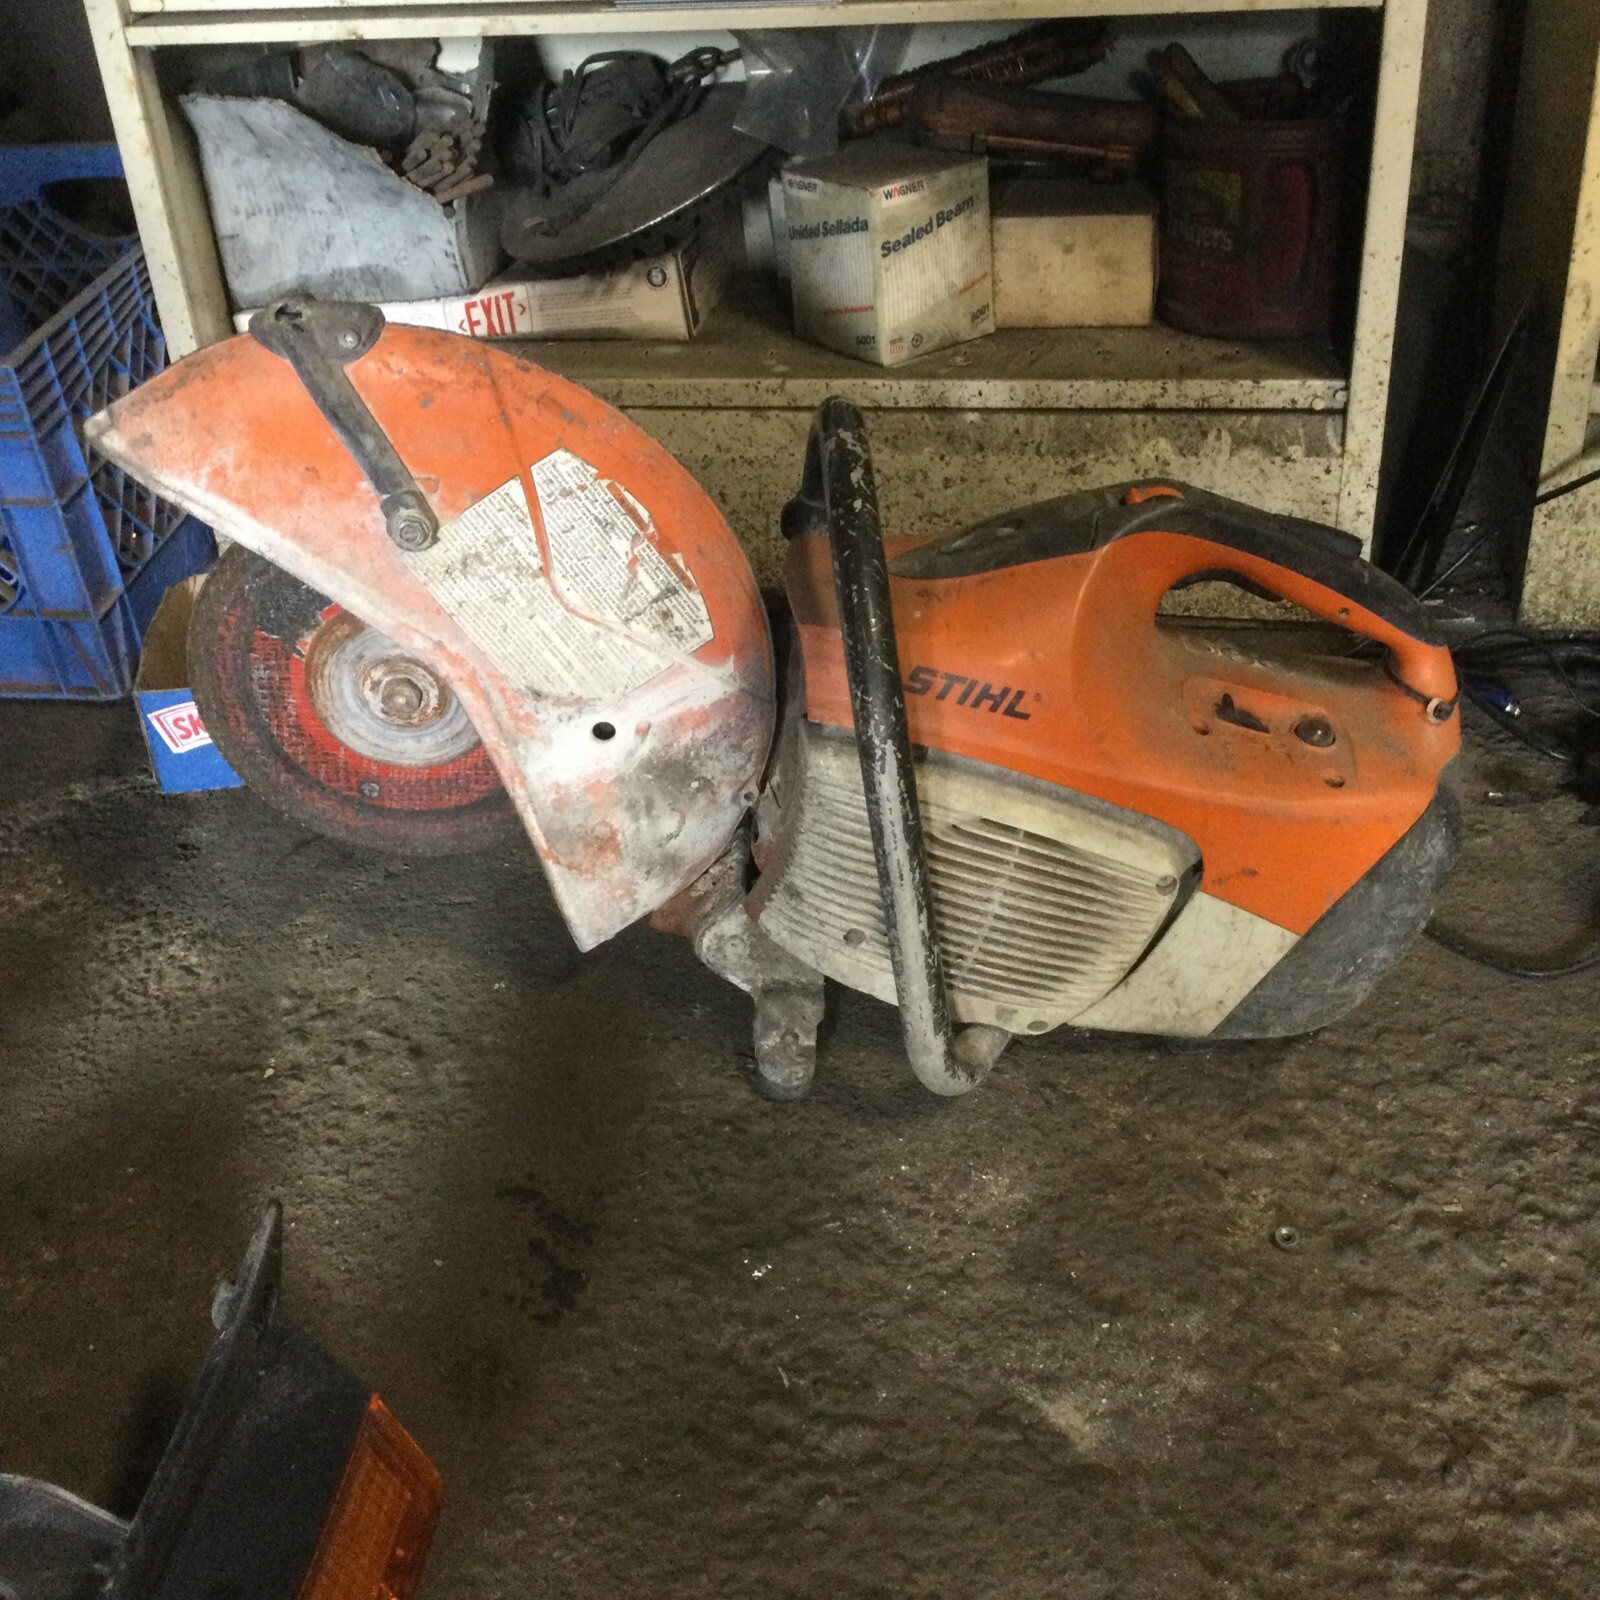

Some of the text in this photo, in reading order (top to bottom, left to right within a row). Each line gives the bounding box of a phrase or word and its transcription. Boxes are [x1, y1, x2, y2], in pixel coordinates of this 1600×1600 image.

[787, 177, 818, 193] WAGNER
[883, 179, 925, 200] WAGNER
[788, 222, 821, 241] Unidad
[880, 197, 975, 258] Sealed Beam
[464, 291, 517, 337] EXIT
[902, 665, 1031, 721] STIHL
